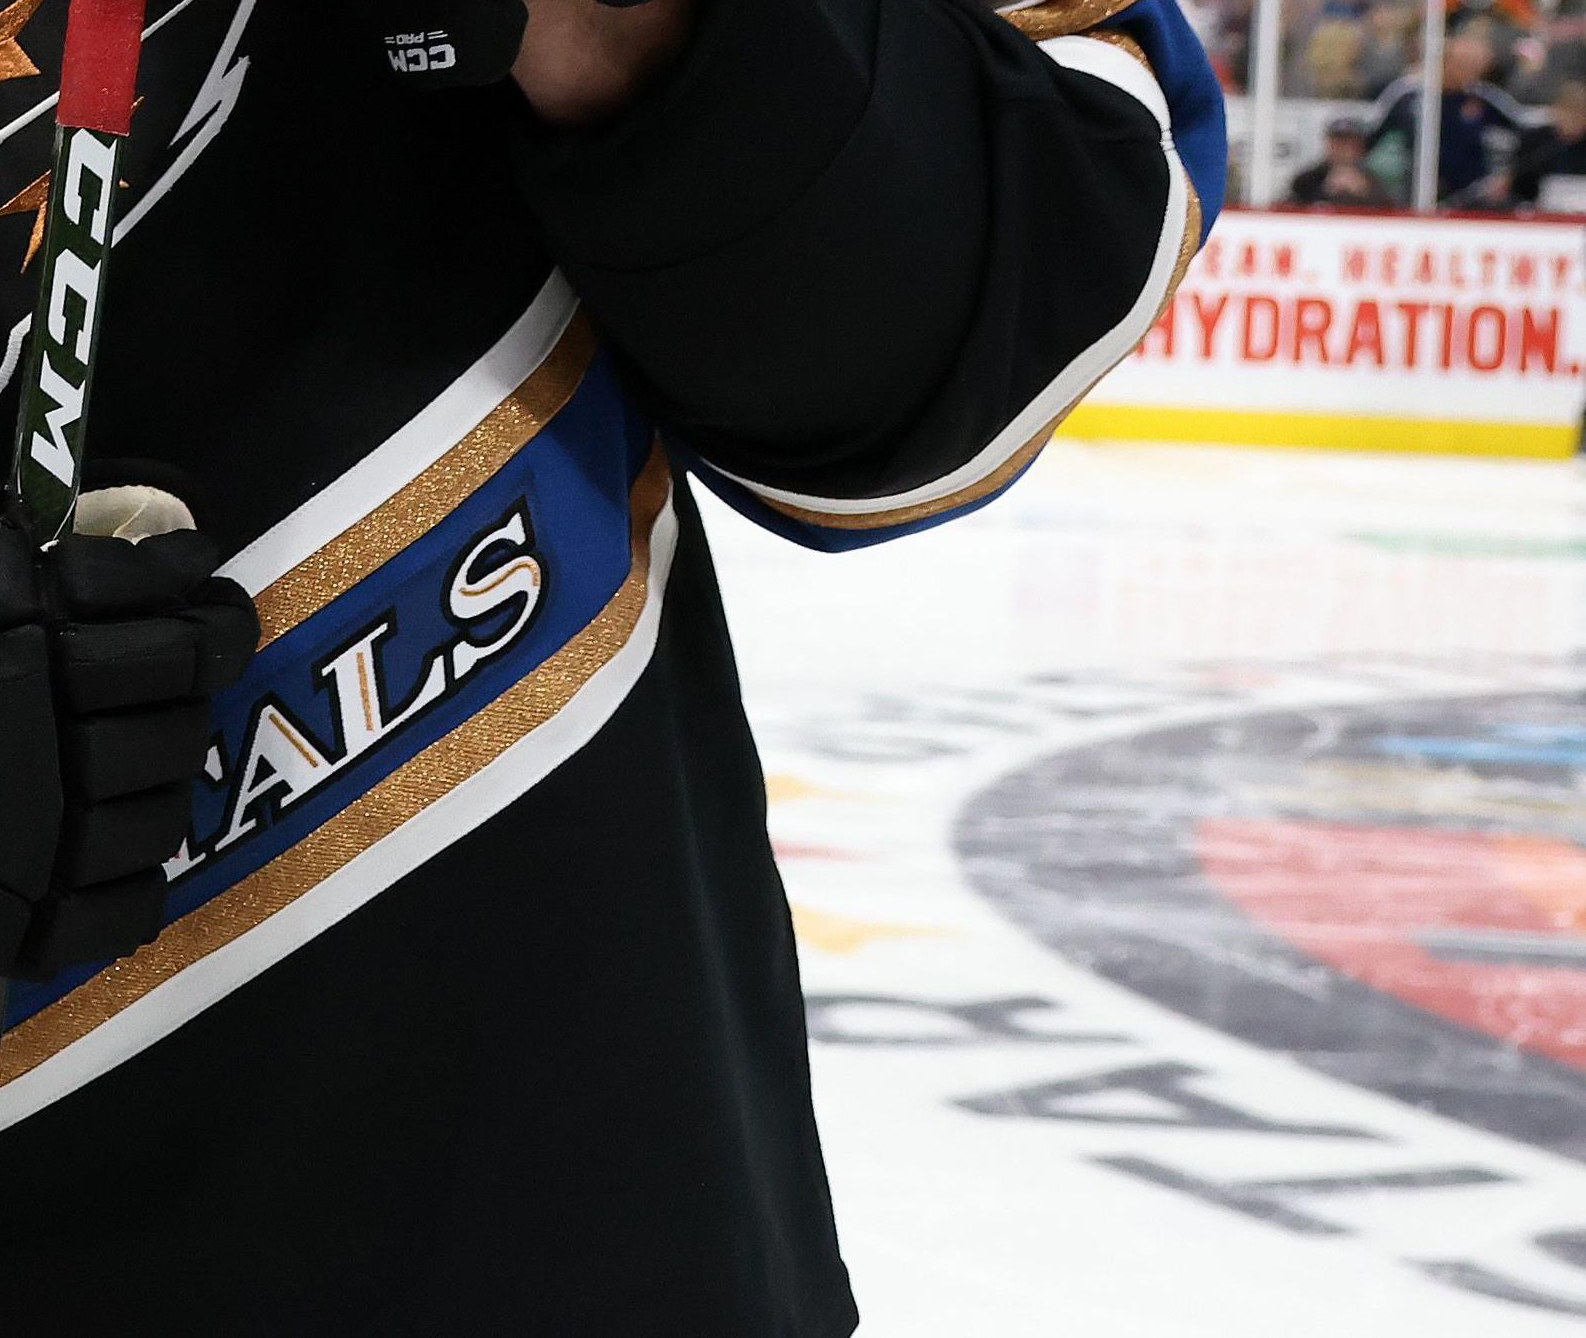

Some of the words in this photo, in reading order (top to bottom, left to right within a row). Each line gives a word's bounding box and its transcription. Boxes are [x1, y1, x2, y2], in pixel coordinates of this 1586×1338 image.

[388, 44, 456, 72] CCM
[395, 31, 425, 45] PRO
[1200, 238, 1318, 284] EAN.
[30, 127, 118, 489] CCM
[1139, 294, 1581, 373] HYDRATION.
